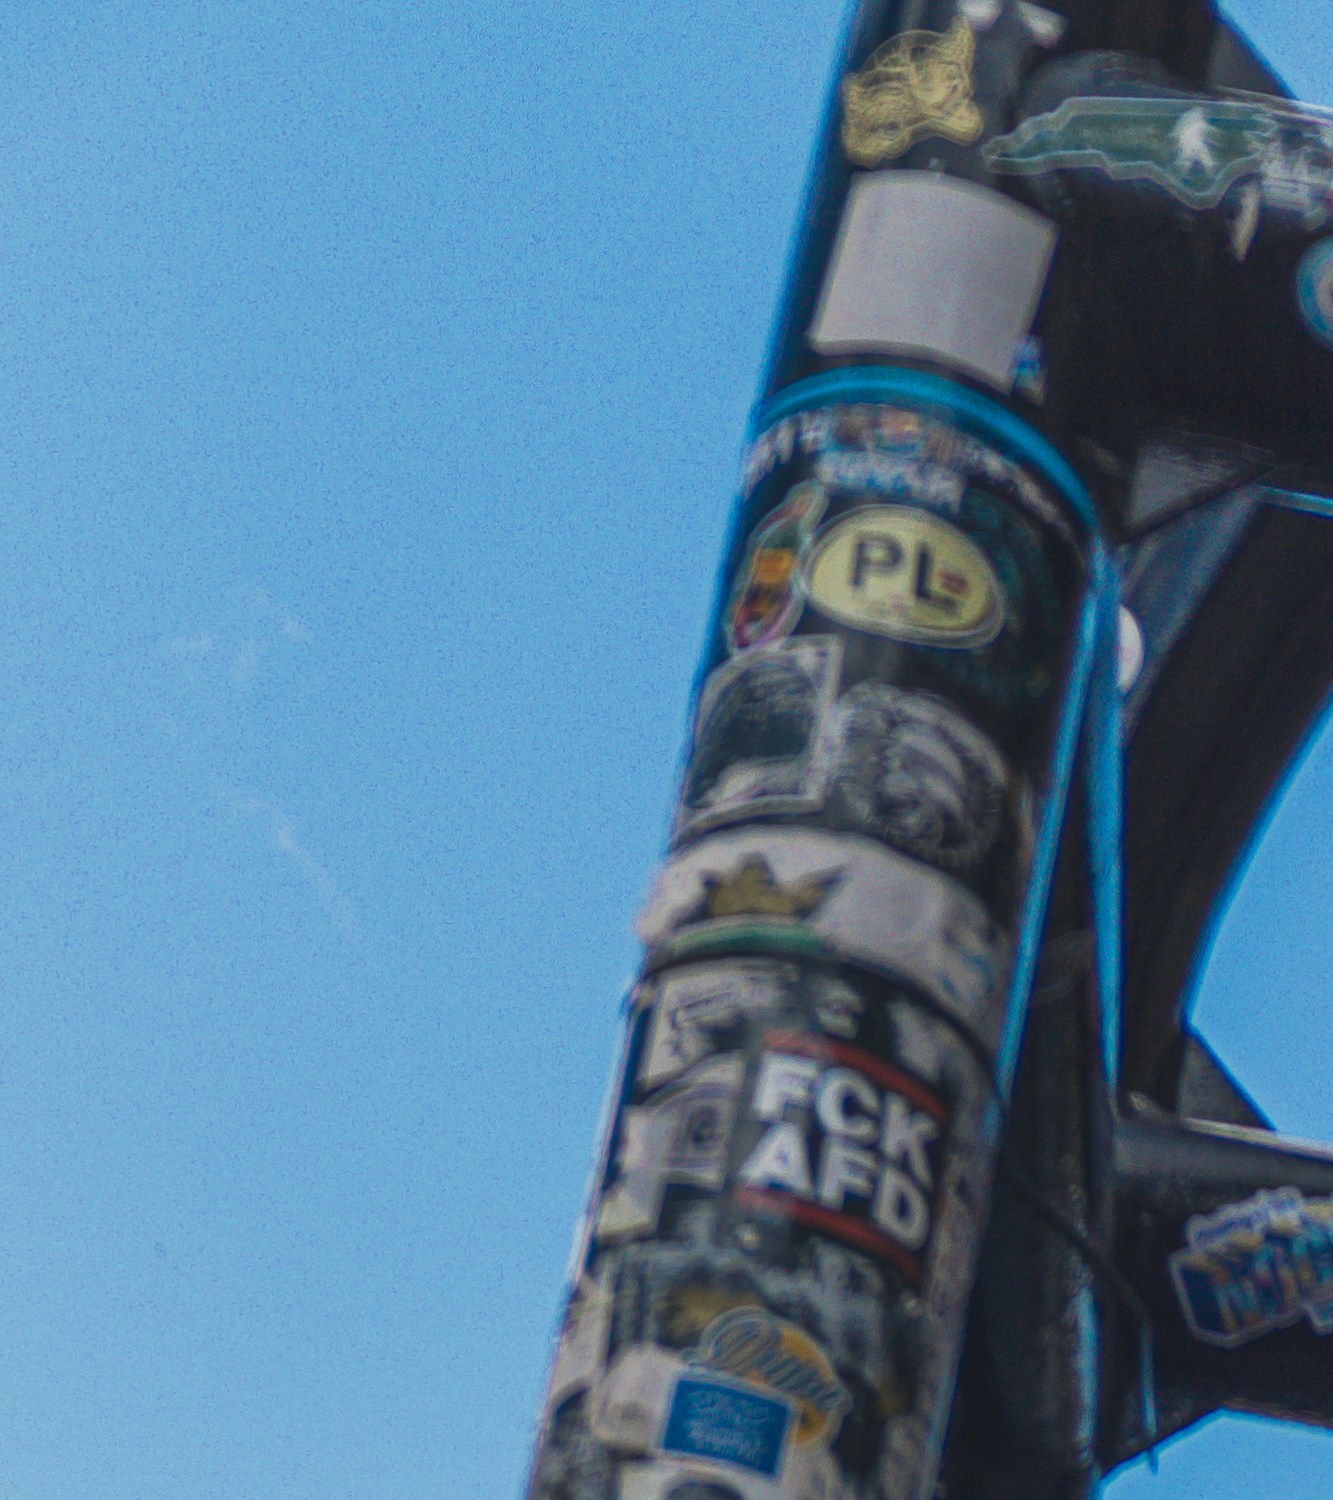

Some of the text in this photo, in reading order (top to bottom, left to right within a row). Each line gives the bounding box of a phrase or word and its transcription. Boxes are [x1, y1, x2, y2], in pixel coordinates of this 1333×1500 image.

[851, 532, 957, 615] PL
[754, 1055, 939, 1182] FCK
[738, 1125, 932, 1250] AFD
